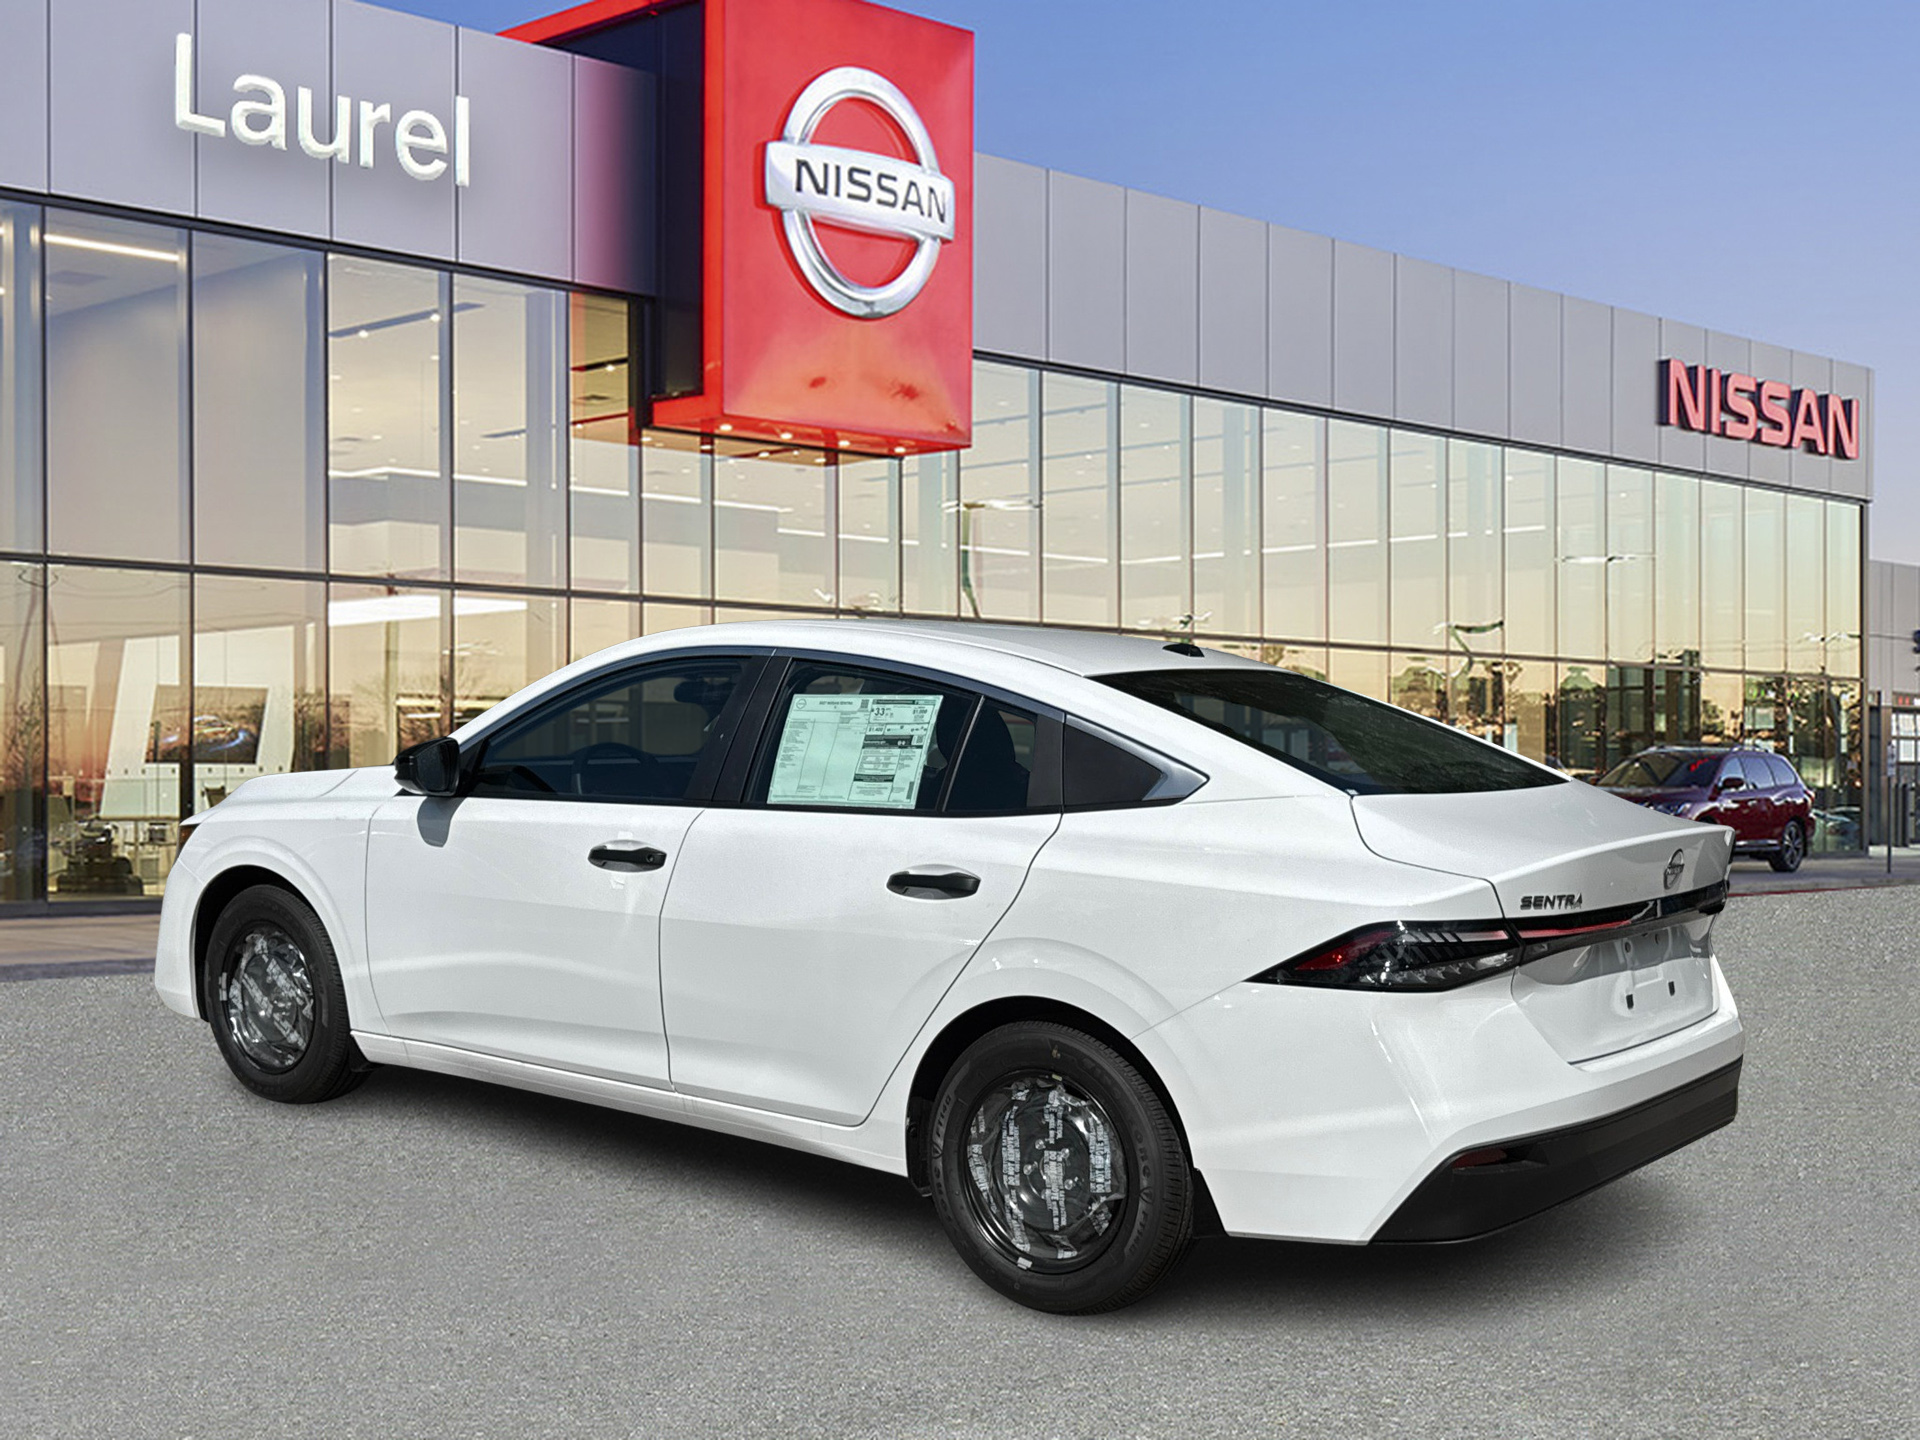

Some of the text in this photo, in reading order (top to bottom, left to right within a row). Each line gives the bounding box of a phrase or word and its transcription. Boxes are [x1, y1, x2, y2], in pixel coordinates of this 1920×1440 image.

[175, 32, 470, 188] Laurel
[795, 158, 947, 224] NISSAN
[1657, 357, 1860, 461] NISSAN
[1520, 892, 1583, 911] SENTRA
